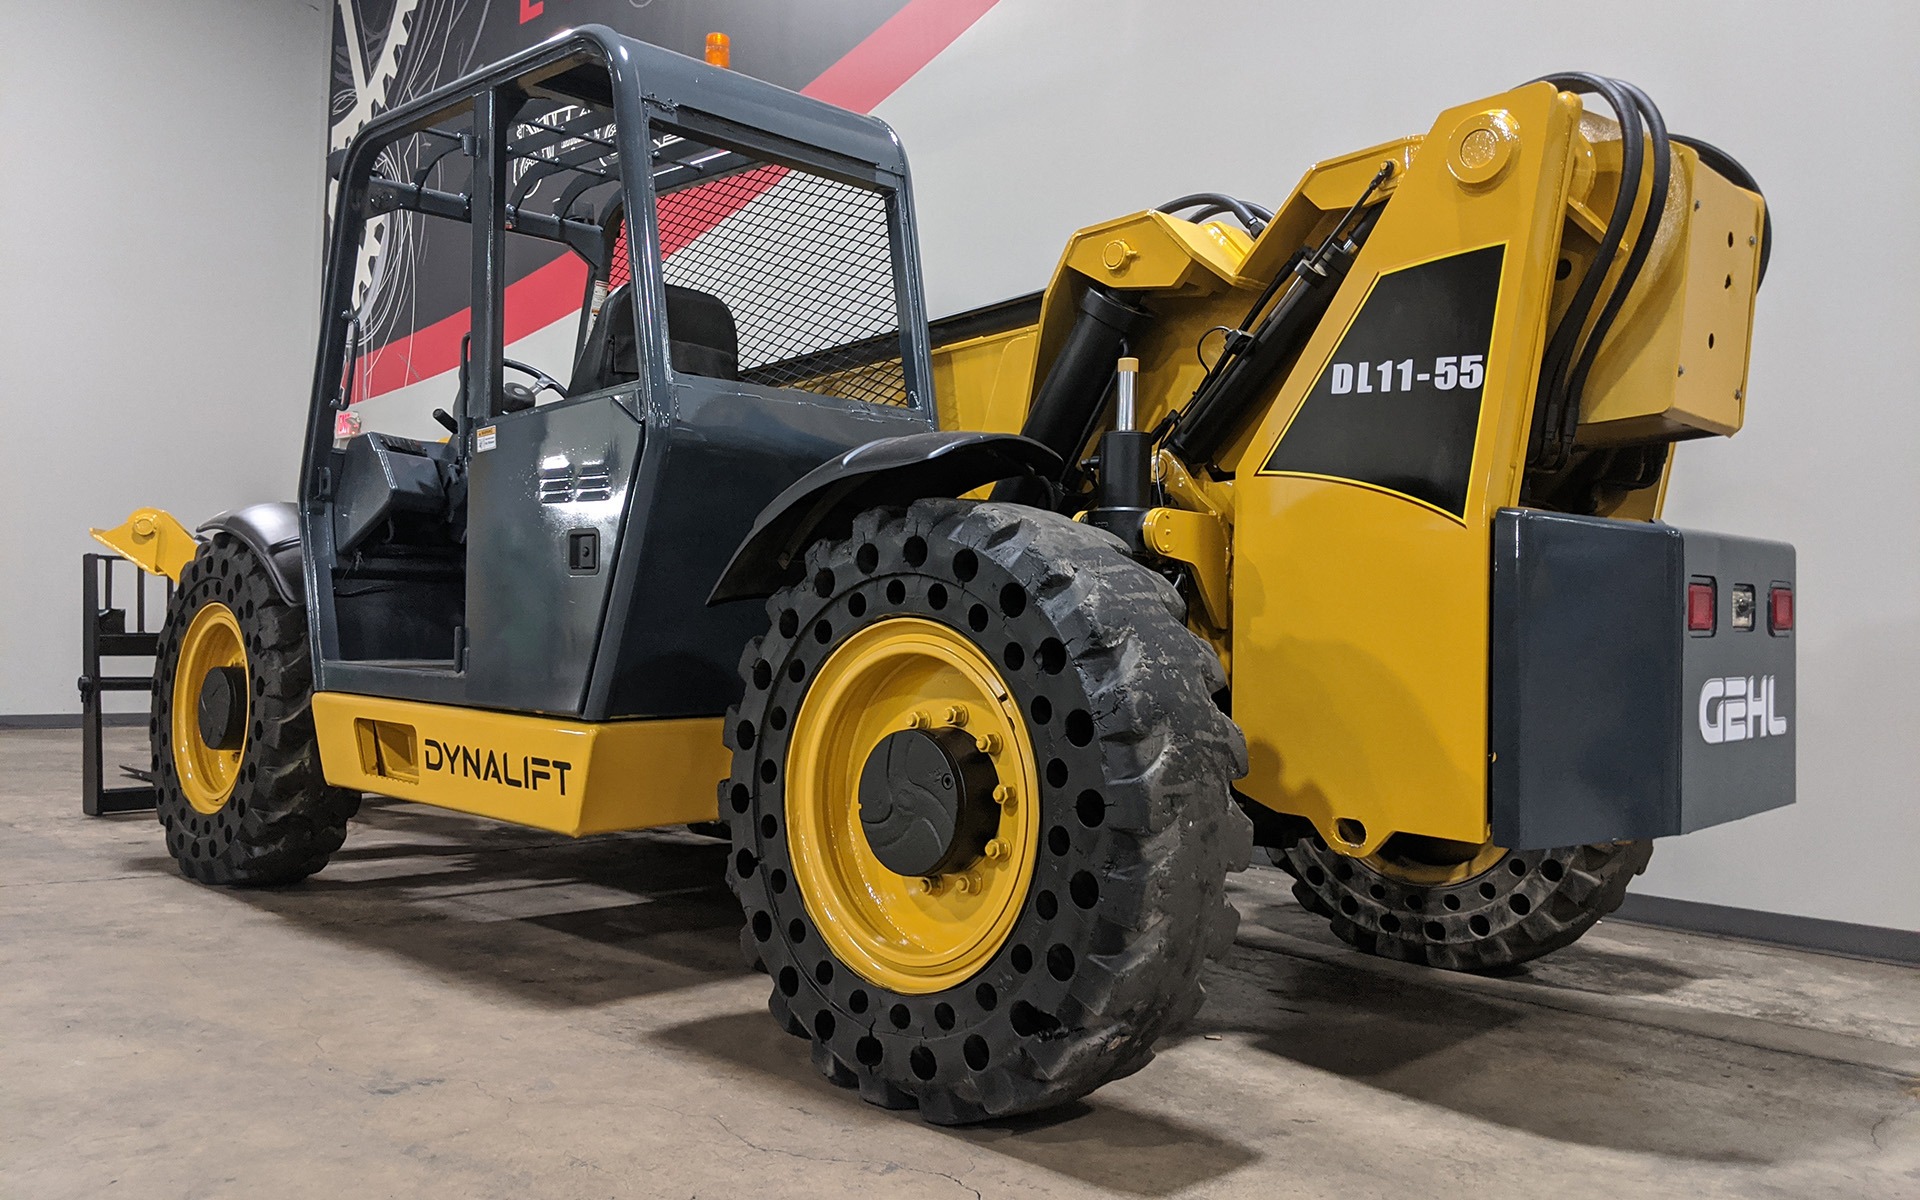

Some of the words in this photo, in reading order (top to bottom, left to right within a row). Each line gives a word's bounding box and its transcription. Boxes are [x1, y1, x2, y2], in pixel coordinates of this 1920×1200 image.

[1331, 355, 1484, 394] DL11-55
[1699, 675, 1787, 744] GEHL
[425, 738, 572, 796] DYNALIFT
